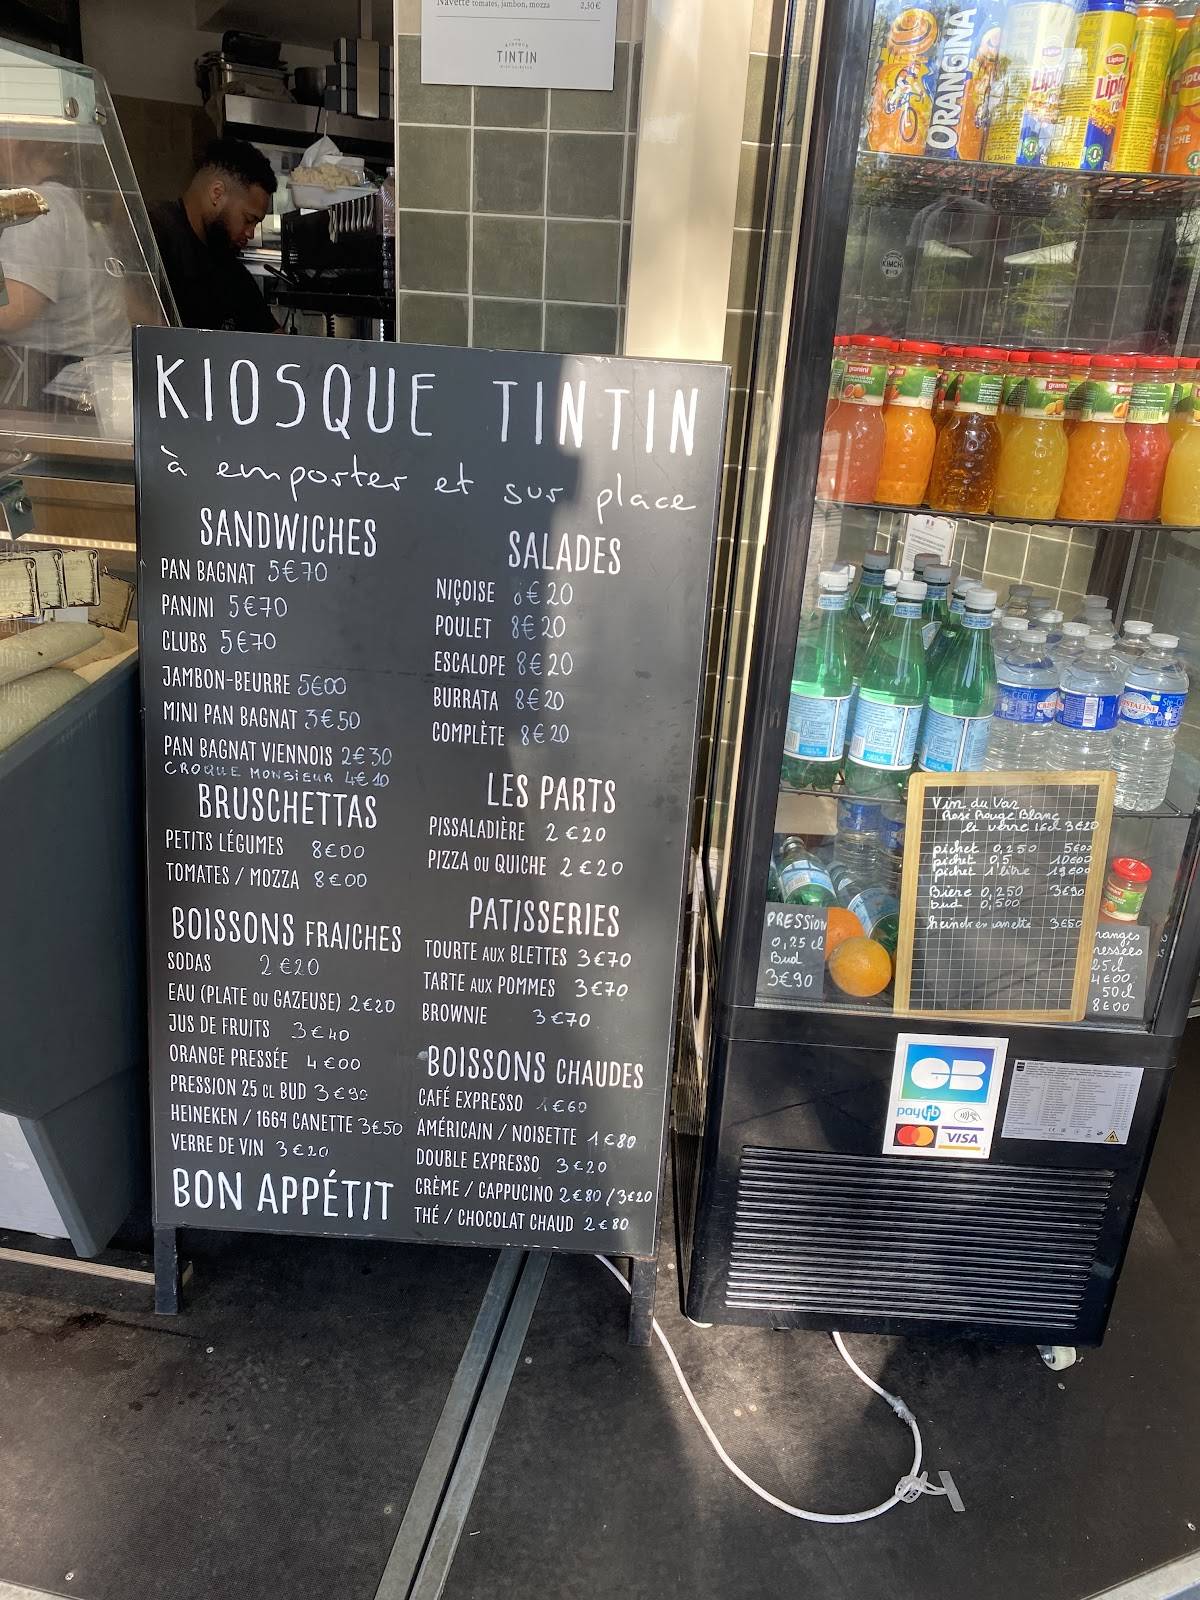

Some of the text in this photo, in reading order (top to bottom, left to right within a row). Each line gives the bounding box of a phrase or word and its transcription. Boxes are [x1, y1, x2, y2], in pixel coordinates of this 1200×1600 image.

[497, 50, 537, 64] TINTIN
[926, 8, 978, 150] ORANGINA
[156, 355, 698, 456] KIOSQUE TINTIN
[161, 445, 696, 524] à emporter et sur place
[200, 507, 377, 557] SANDWICHES
[508, 530, 621, 575] SALADES
[161, 558, 328, 585] PAN BAGNAT 5€70
[436, 578, 495, 606] NIÇOISE
[162, 594, 288, 618] PANINI 5€70
[435, 614, 566, 640] POULET 8€20
[162, 629, 276, 654] CLUBS 5€70
[434, 650, 573, 676] ESCALOPE 8€20
[162, 666, 347, 696] JAMBON-BEURRE 5€00
[433, 687, 564, 711] BURRATA 8€20
[163, 701, 361, 731] MINI PAN BAGNAT 3€50
[432, 720, 569, 746] COMPLÈTE 8€20
[164, 735, 392, 766] PAN BAGNAT VIENNOIS 2€30
[164, 761, 241, 777] CROQUE
[198, 783, 377, 829] BRUSCHETTAS
[487, 772, 616, 814] LES PARTS
[932, 797, 966, 809] Vin
[970, 797, 988, 809] du
[961, 822, 979, 833] le
[988, 819, 1029, 832] verre
[1019, 809, 1060, 820] Blanc
[429, 816, 525, 841] PISSALADIÈRE
[166, 829, 365, 858] PETITS LÉGUMES 8€00
[933, 840, 980, 859] pichet
[428, 849, 469, 871] PIZZA
[495, 854, 547, 876] QUICHE
[933, 854, 976, 872] pichet
[934, 865, 1031, 883] pichet litre
[166, 863, 229, 885] TOMATES
[250, 867, 300, 889] MOZZA
[930, 898, 963, 909] bud
[172, 906, 402, 952] BOISSONS FRAICHES
[469, 896, 620, 938] PATISSERIES
[811, 936, 824, 950] cl
[1095, 931, 1140, 947] ranges
[167, 951, 212, 972] SODAS
[425, 940, 631, 967] TOURTE BLETTES 3€70
[770, 951, 803, 964] Bud
[423, 971, 628, 997] TARTE POMMES 3€70
[766, 968, 813, 988] 3€90
[168, 982, 395, 1013] EAU (PLATE GAZEUSE) 2€20
[1092, 998, 1130, 1012] 8€00
[168, 1014, 194, 1034] JUS
[200, 1016, 217, 1035] DE
[222, 1017, 270, 1038] FRUITS
[422, 1003, 487, 1025] BROWNIE
[169, 1044, 225, 1066] ORANGE
[231, 1047, 288, 1069] PRESSÉE
[428, 1045, 644, 1089] BOISSONS CHAUDES
[910, 1057, 986, 1091] CB
[170, 1075, 236, 1095] PRESSION
[241, 1079, 257, 1097] 25
[280, 1082, 307, 1100] BUD
[418, 1086, 523, 1112] CAFÉ EXPRESSO
[171, 1104, 403, 1135] HEINEKEN 1664 CANETTE 3€50
[417, 1116, 493, 1140] AMÉRICAIN
[512, 1124, 577, 1145] NOISETTE
[171, 1133, 213, 1153] VERRE
[219, 1136, 234, 1155] DE
[240, 1138, 264, 1156] VIN
[947, 1133, 978, 1143] VISA
[416, 1148, 467, 1169] DOUBLE
[473, 1152, 540, 1173] EXPRESSO
[172, 1168, 394, 1221] BON APPÉTIT
[415, 1175, 460, 1197] CRÈME
[478, 1181, 553, 1203] CAPPUCINO
[414, 1204, 439, 1224] THÉ
[457, 1209, 525, 1230] CHOCOLAT
[529, 1213, 574, 1232] CHAUD
